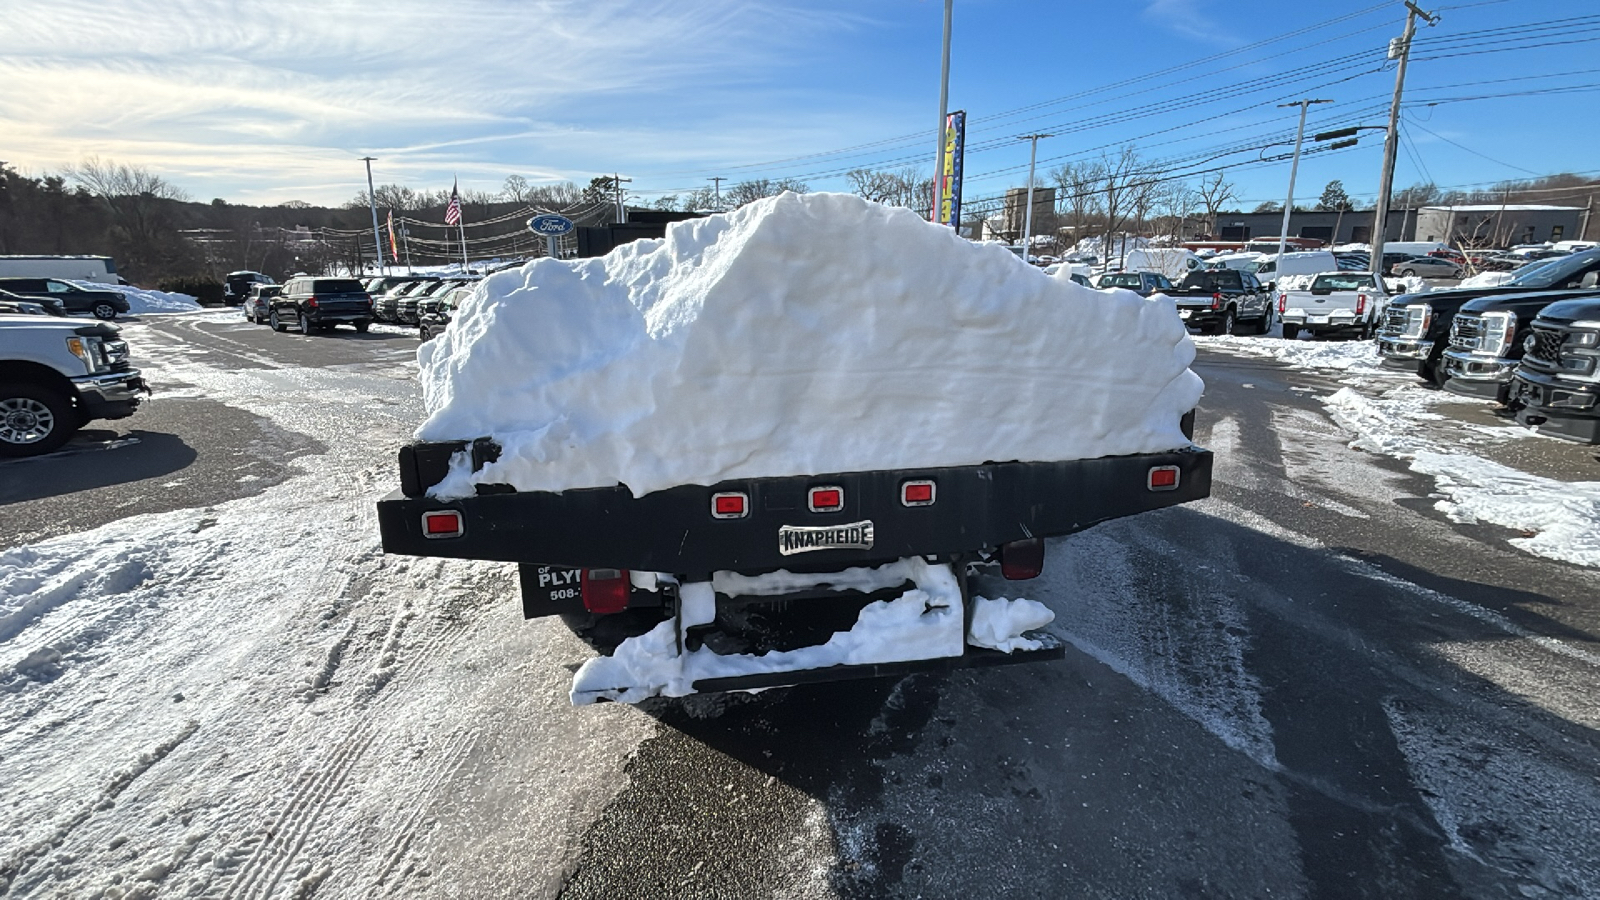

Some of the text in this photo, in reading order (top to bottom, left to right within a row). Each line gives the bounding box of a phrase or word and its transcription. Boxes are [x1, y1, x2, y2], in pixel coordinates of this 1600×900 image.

[540, 219, 566, 231] Ford
[784, 525, 870, 552] KNAPHEIDE
[537, 566, 551, 574] OF
[550, 587, 582, 601] 508-
